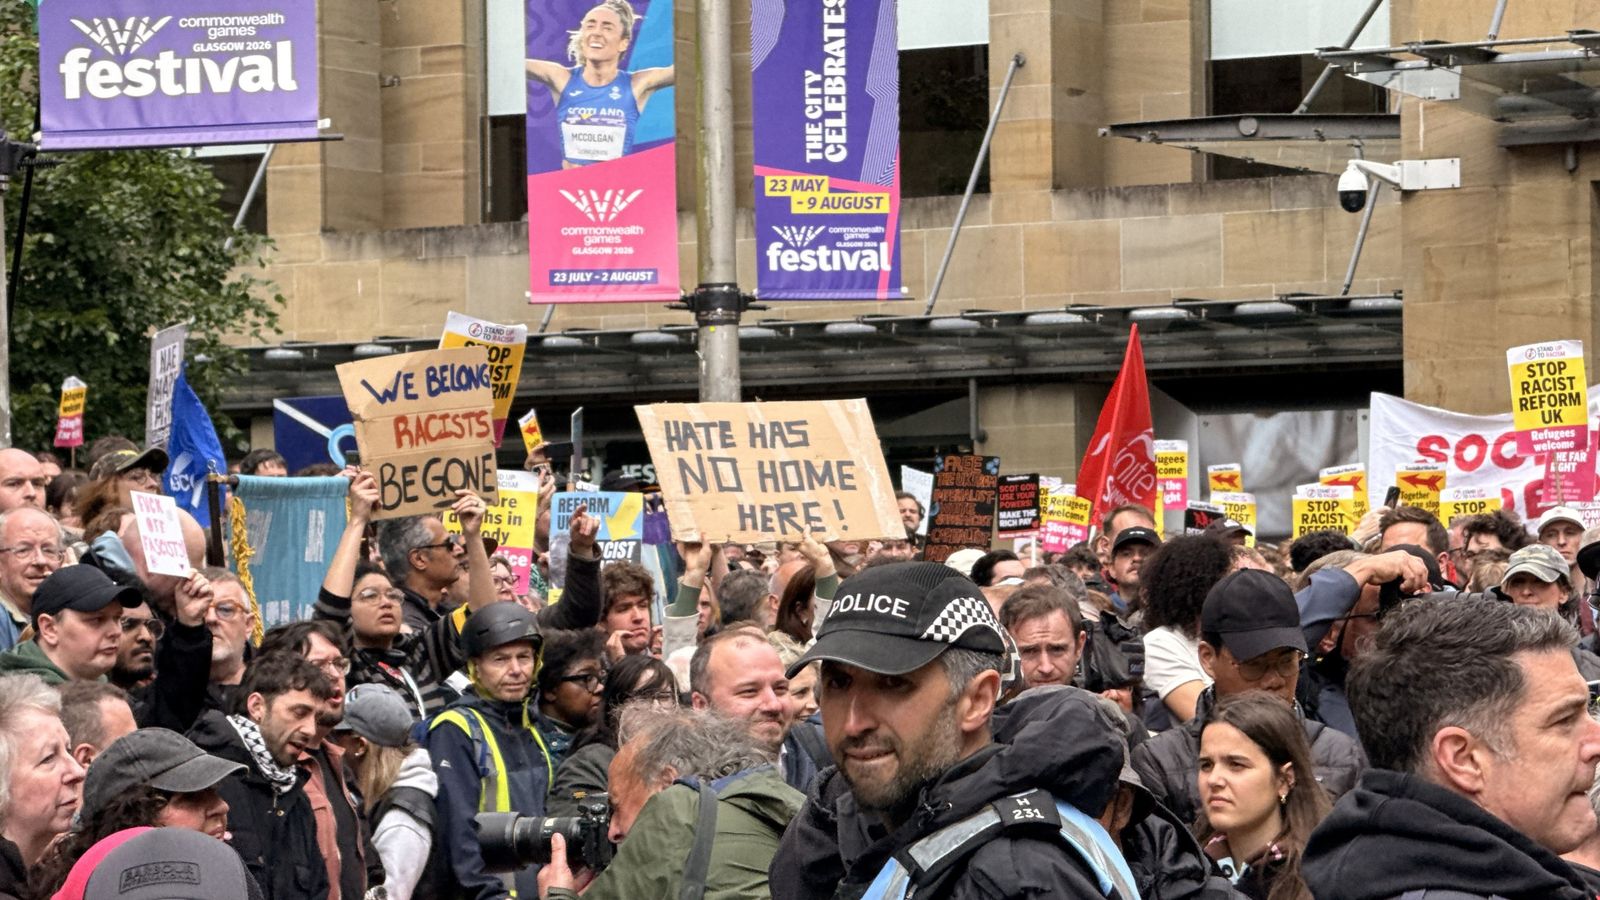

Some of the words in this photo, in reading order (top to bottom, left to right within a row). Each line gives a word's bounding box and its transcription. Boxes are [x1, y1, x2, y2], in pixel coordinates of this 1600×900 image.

[179, 13, 284, 28] commonwealth
[207, 26, 256, 40] games
[193, 41, 243, 52] GLASGOW
[245, 40, 272, 50] 2026
[59, 40, 298, 99] festival
[805, 70, 822, 119] CITY
[805, 122, 822, 163] THE
[769, 179, 787, 192] 23
[791, 179, 825, 192] MAY
[807, 197, 818, 210] 9
[820, 196, 885, 210] AUGUST
[560, 225, 644, 236] commonwealth
[828, 226, 885, 234] commonwealth
[583, 235, 622, 246] games
[844, 233, 870, 241] games
[572, 246, 612, 255] GLASGOW
[767, 242, 891, 271] festival
[553, 272, 569, 283] 23
[570, 272, 593, 283] JULY
[602, 271, 611, 282] 2
[612, 270, 654, 282] AUGUST
[484, 326, 505, 336] STAND
[1526, 361, 1567, 378] STOP
[361, 370, 419, 404] WE
[425, 363, 490, 398] BELONG
[1521, 376, 1576, 395] RACIST
[1519, 392, 1581, 411] REFORM
[1541, 409, 1563, 424] UK
[393, 410, 491, 449] RACISTS
[664, 420, 737, 452] HATE
[747, 420, 810, 449] HAS
[1531, 429, 1576, 441] Refugees
[1533, 440, 1575, 452] welcome
[677, 453, 743, 494] NO
[757, 460, 857, 492] HOME
[1550, 462, 1577, 473] RGHT
[1050, 497, 1088, 511] Refugees
[1307, 500, 1339, 512] STOP
[1453, 501, 1487, 513] STOP
[999, 510, 1022, 519] MAKE
[1022, 509, 1037, 517] THE
[1048, 509, 1085, 521] welcome
[1301, 513, 1345, 524] RACIST
[999, 518, 1018, 527] RICH
[1018, 518, 1033, 526] PAY
[1046, 522, 1068, 534] Stop
[597, 541, 637, 560] CIST
[829, 594, 910, 618] POLICE
[1016, 798, 1030, 806] H
[1012, 808, 1045, 820] 231
